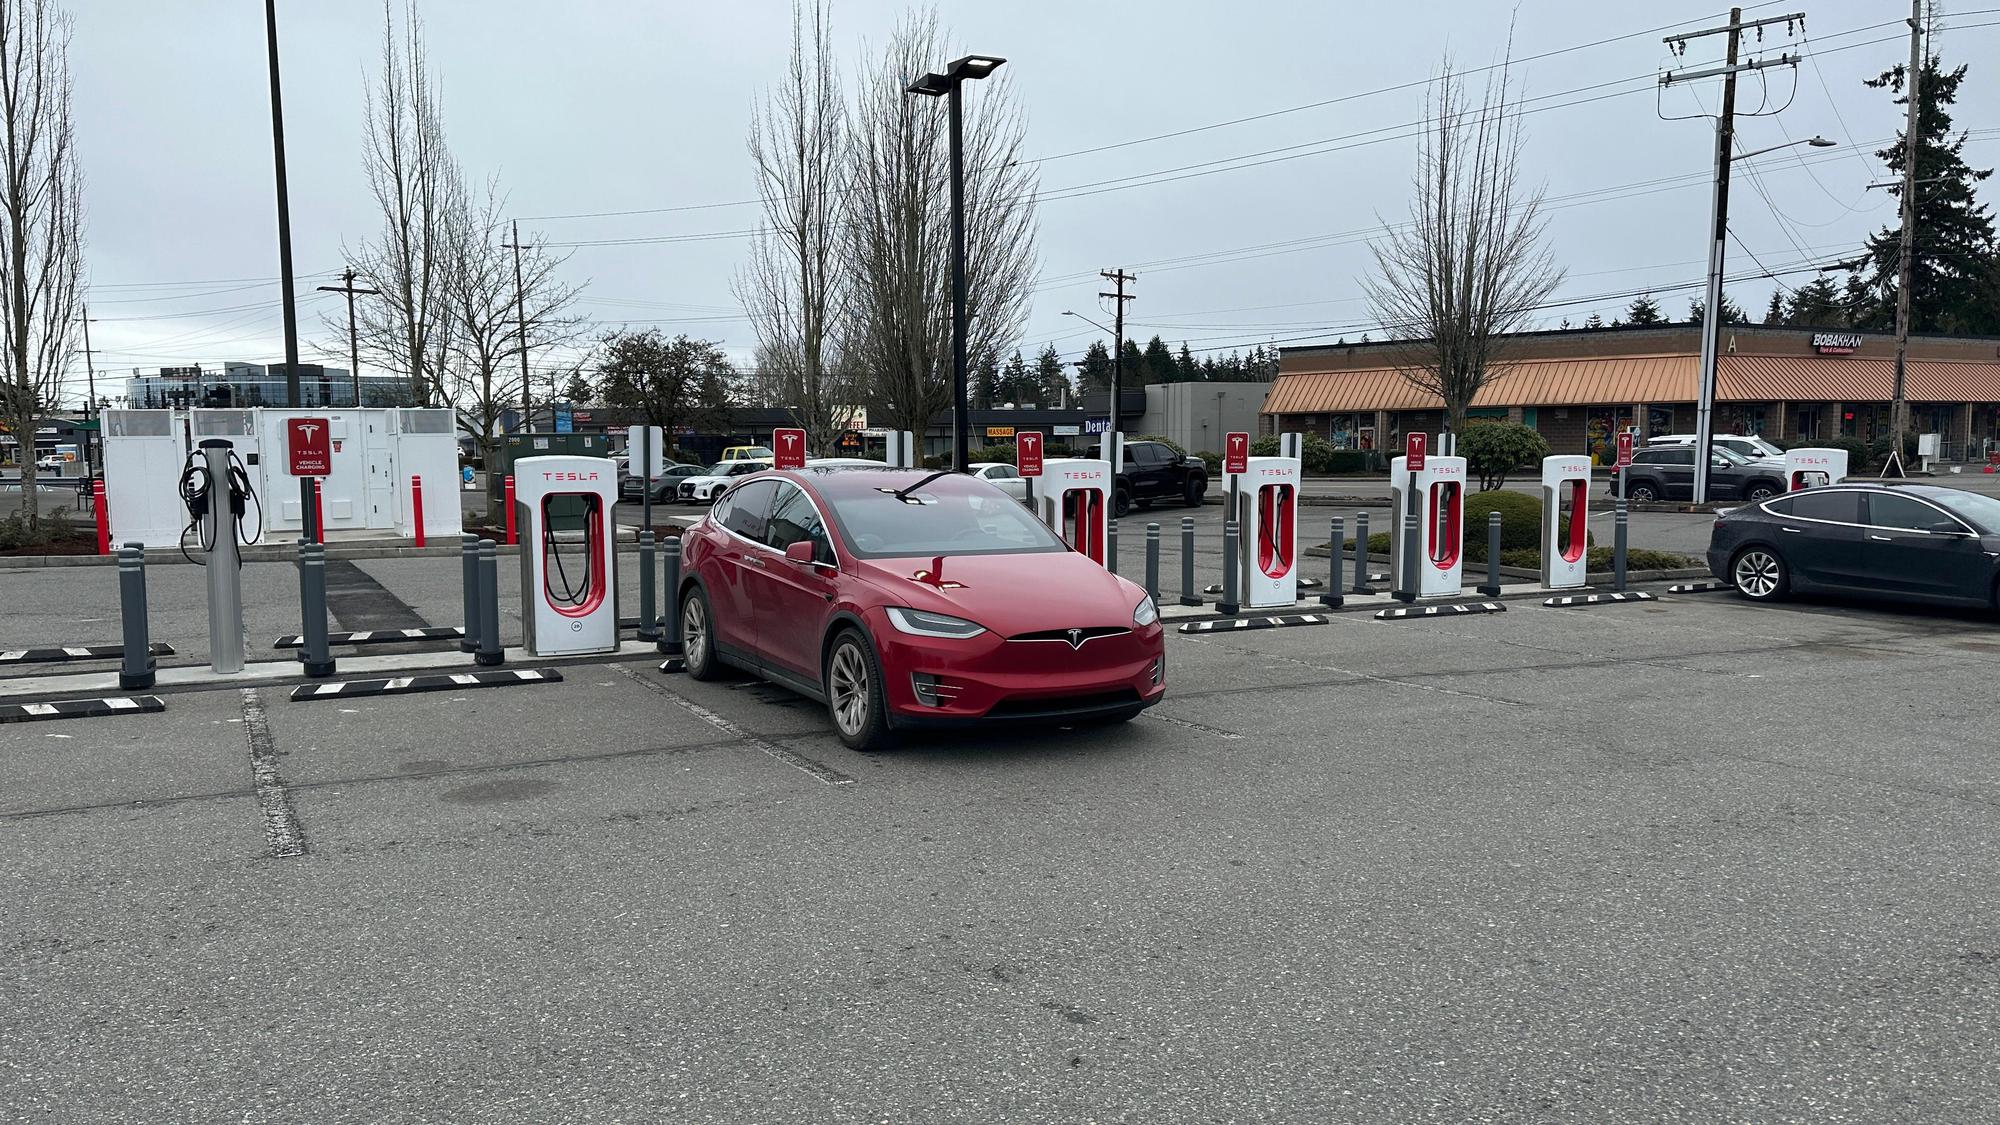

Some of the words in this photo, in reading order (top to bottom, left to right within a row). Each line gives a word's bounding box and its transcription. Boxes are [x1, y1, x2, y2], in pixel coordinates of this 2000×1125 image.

[1728, 335, 1737, 353] A
[1813, 333, 1863, 347] BOBAKHAN
[841, 421, 864, 429] BFFET
[1085, 420, 1112, 433] Denta
[988, 428, 1014, 436] MASSAGE
[543, 472, 598, 481] TESLA
[1261, 468, 1293, 476] TESLA
